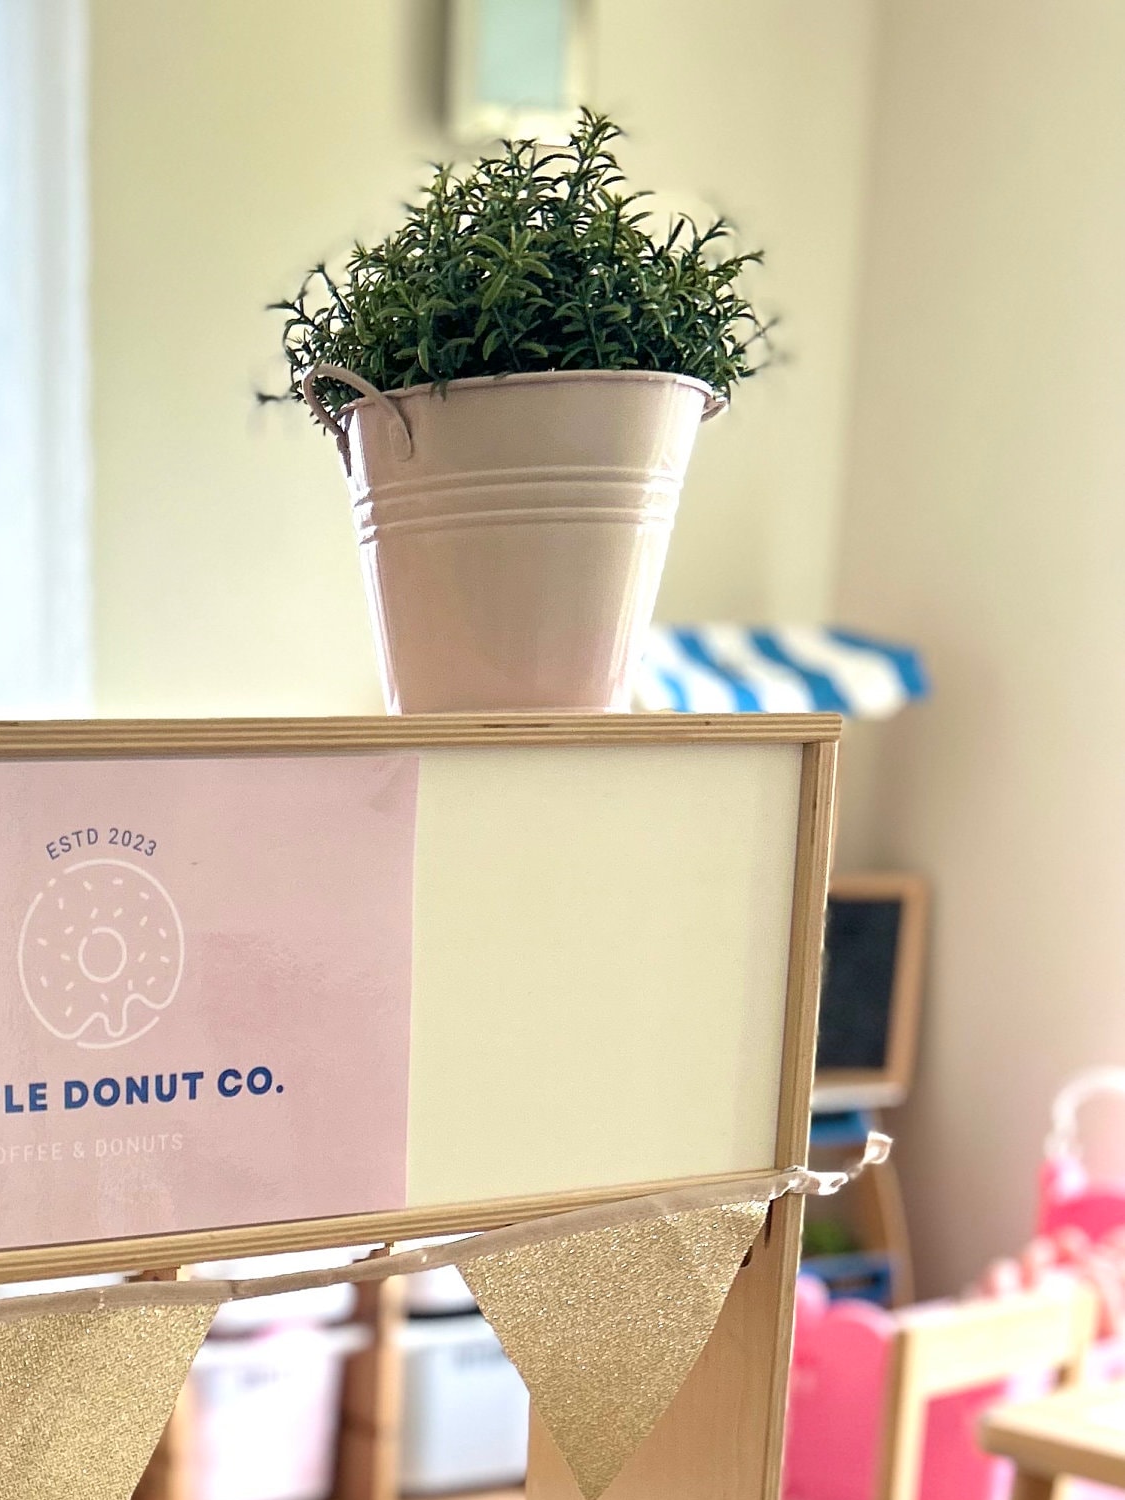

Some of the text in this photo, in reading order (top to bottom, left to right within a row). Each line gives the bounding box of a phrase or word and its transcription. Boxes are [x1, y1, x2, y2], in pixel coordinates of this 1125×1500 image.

[45, 827, 158, 860] ESTD 2023
[64, 1071, 204, 1110] DONUT
[217, 1066, 284, 1097] CO.
[73, 1142, 85, 1158] &
[94, 1133, 184, 1158] DONUTS
